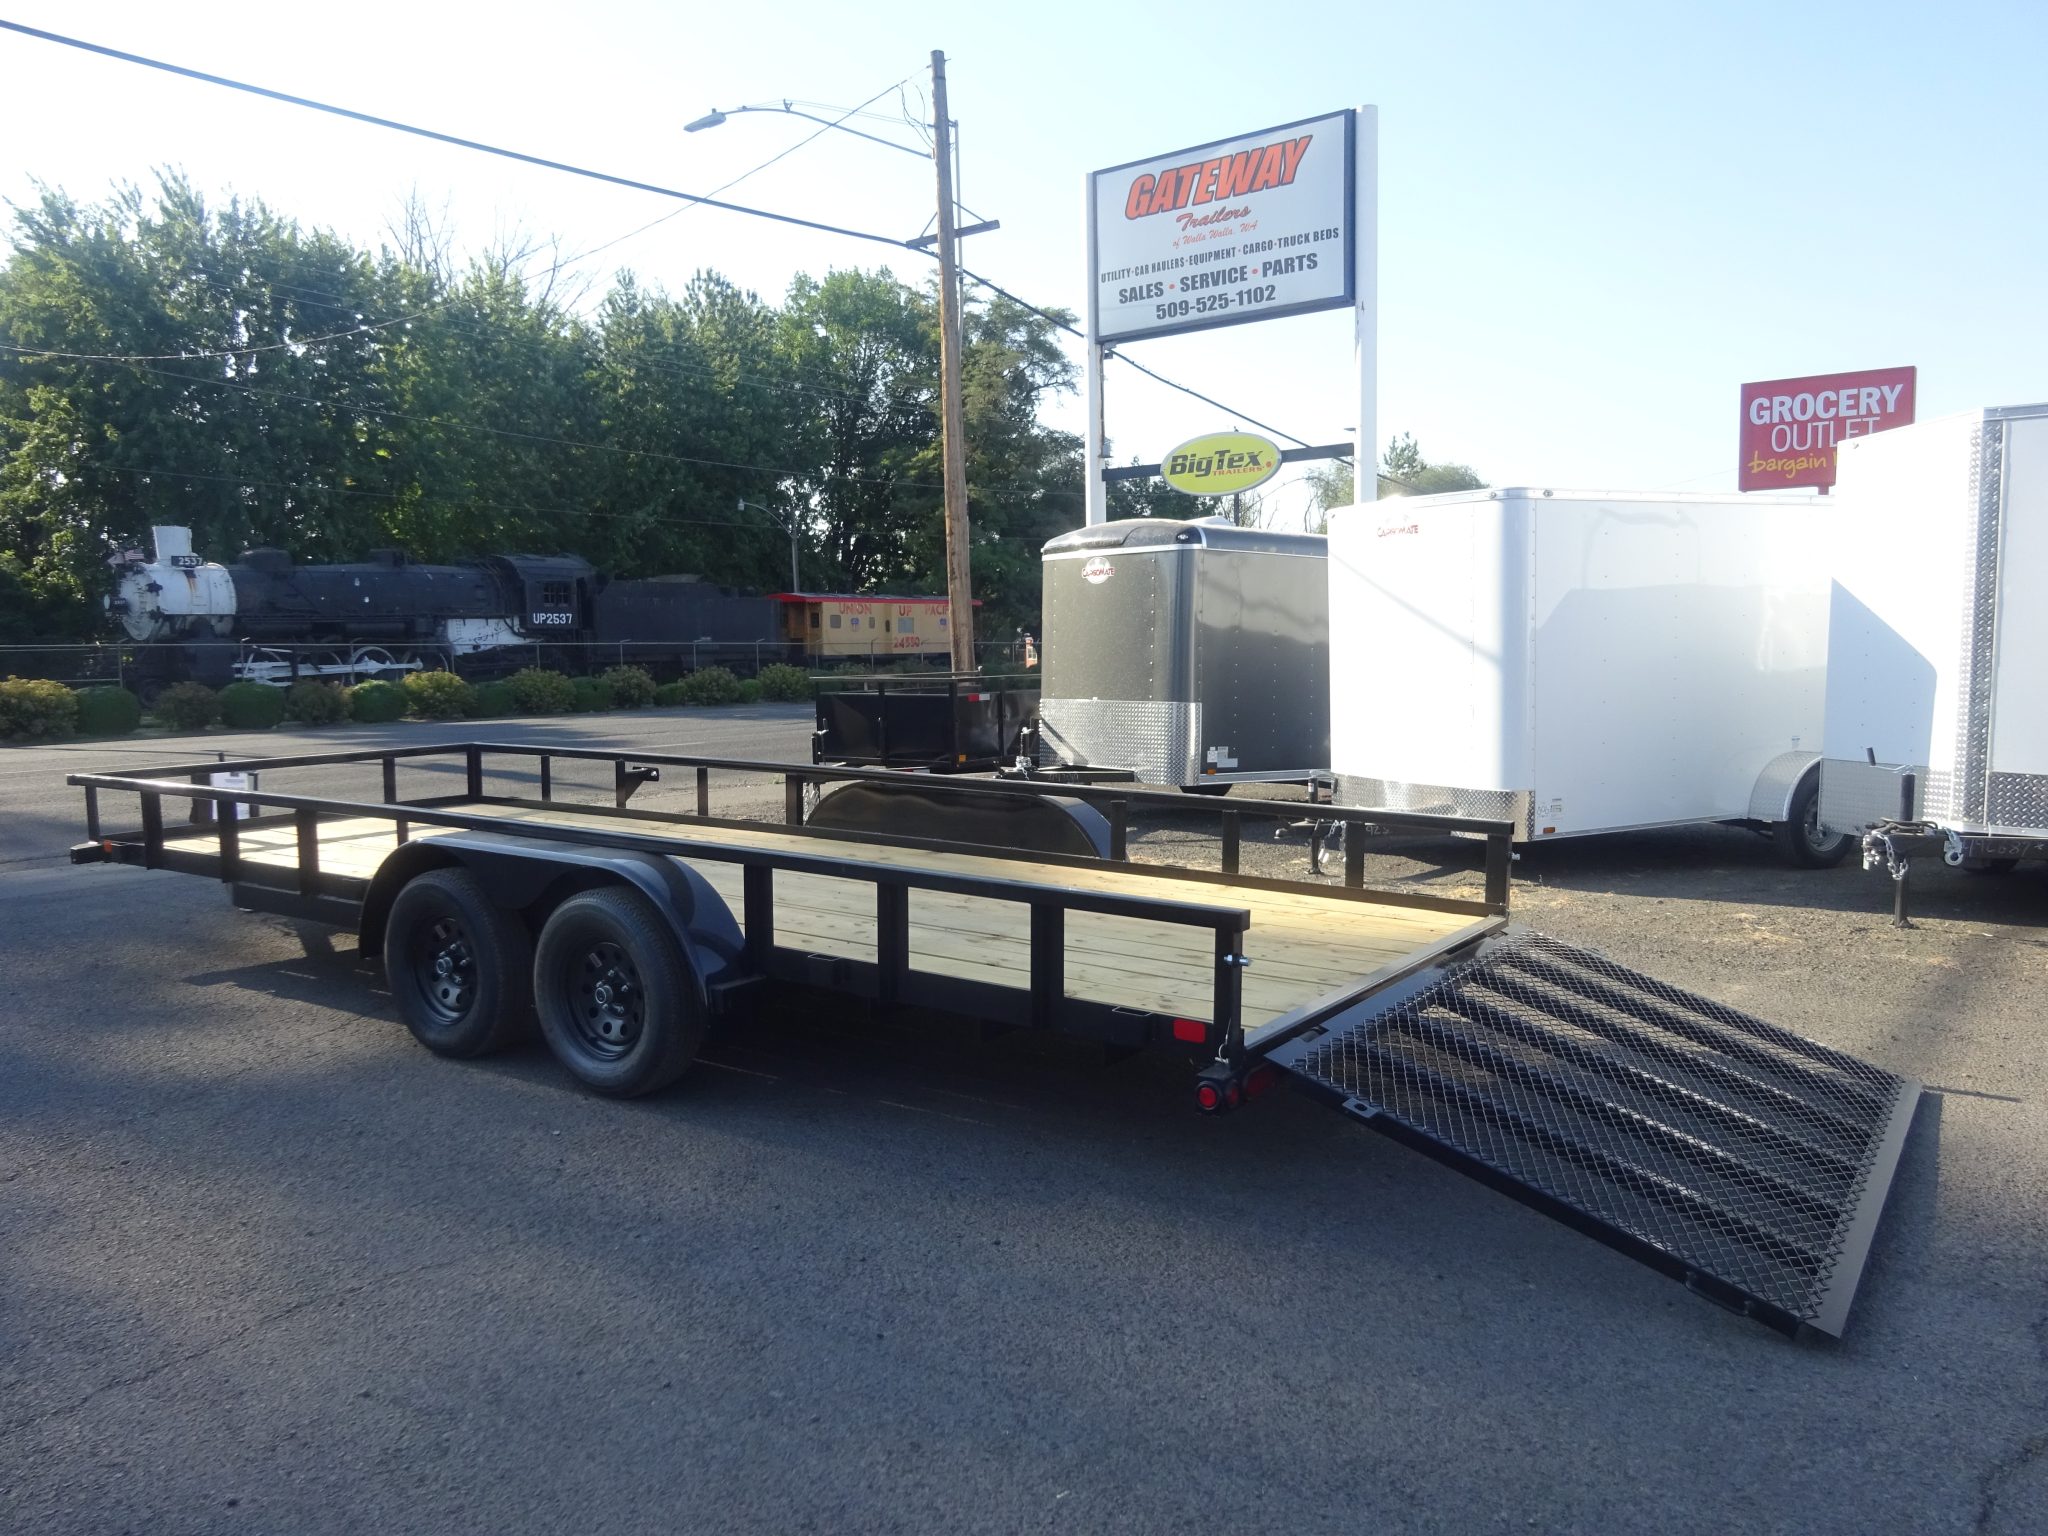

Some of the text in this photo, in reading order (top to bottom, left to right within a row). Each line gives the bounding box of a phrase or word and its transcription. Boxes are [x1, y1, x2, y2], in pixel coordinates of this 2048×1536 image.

[1125, 134, 1313, 220] GATEWAY
[1175, 206, 1252, 231] Trailers
[1172, 239, 1181, 249] of
[1183, 231, 1206, 245] Walla
[1240, 219, 1259, 233] WA
[1101, 227, 1340, 283] UTILITY CAR HAULERS EQUIPMENT CARGO TRUCK BEDS
[1118, 252, 1319, 304] SALES SERVICE PARTS
[1156, 284, 1277, 321] 509-525-1102
[1749, 383, 1904, 426] GROCERY
[1770, 416, 1881, 453] OUTLET
[1212, 467, 1263, 477] TRAILERS
[1747, 450, 1827, 479] bargain
[178, 556, 203, 566] 2537
[533, 612, 573, 624] UP2537
[839, 603, 872, 615] UNION
[899, 604, 913, 617] UP
